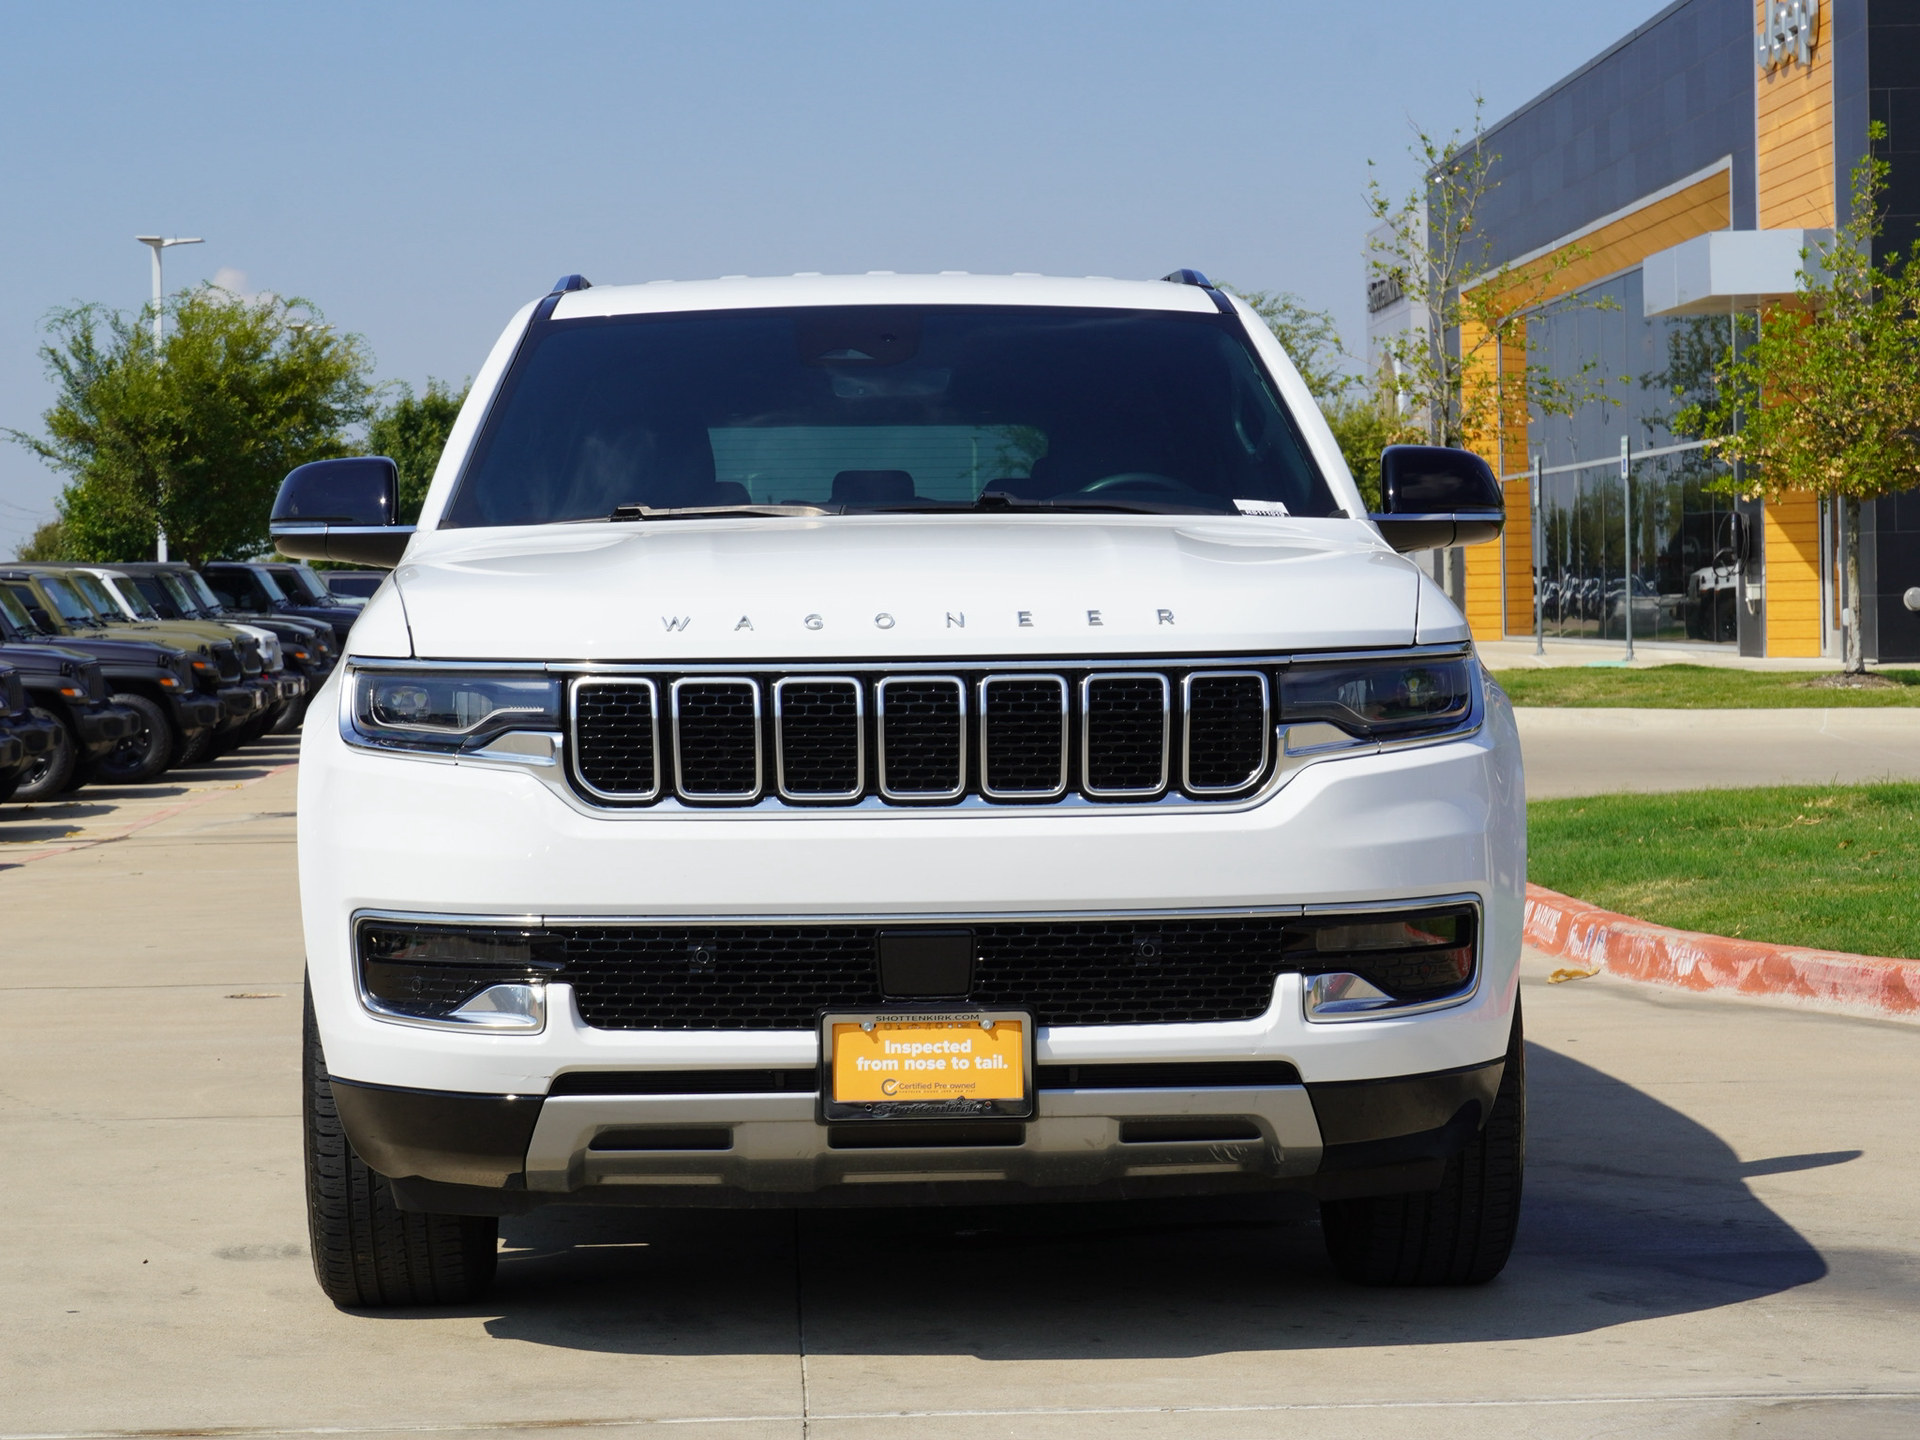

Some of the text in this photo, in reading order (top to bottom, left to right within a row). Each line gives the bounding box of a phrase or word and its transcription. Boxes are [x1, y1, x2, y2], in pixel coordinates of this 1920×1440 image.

[661, 608, 1175, 632] WAGONEER
[875, 1014, 980, 1022] SHOTTENKIRK.COM
[884, 1039, 972, 1057] Inspected
[856, 1054, 1009, 1071] from nose to tail.
[899, 1082, 933, 1090] Certified
